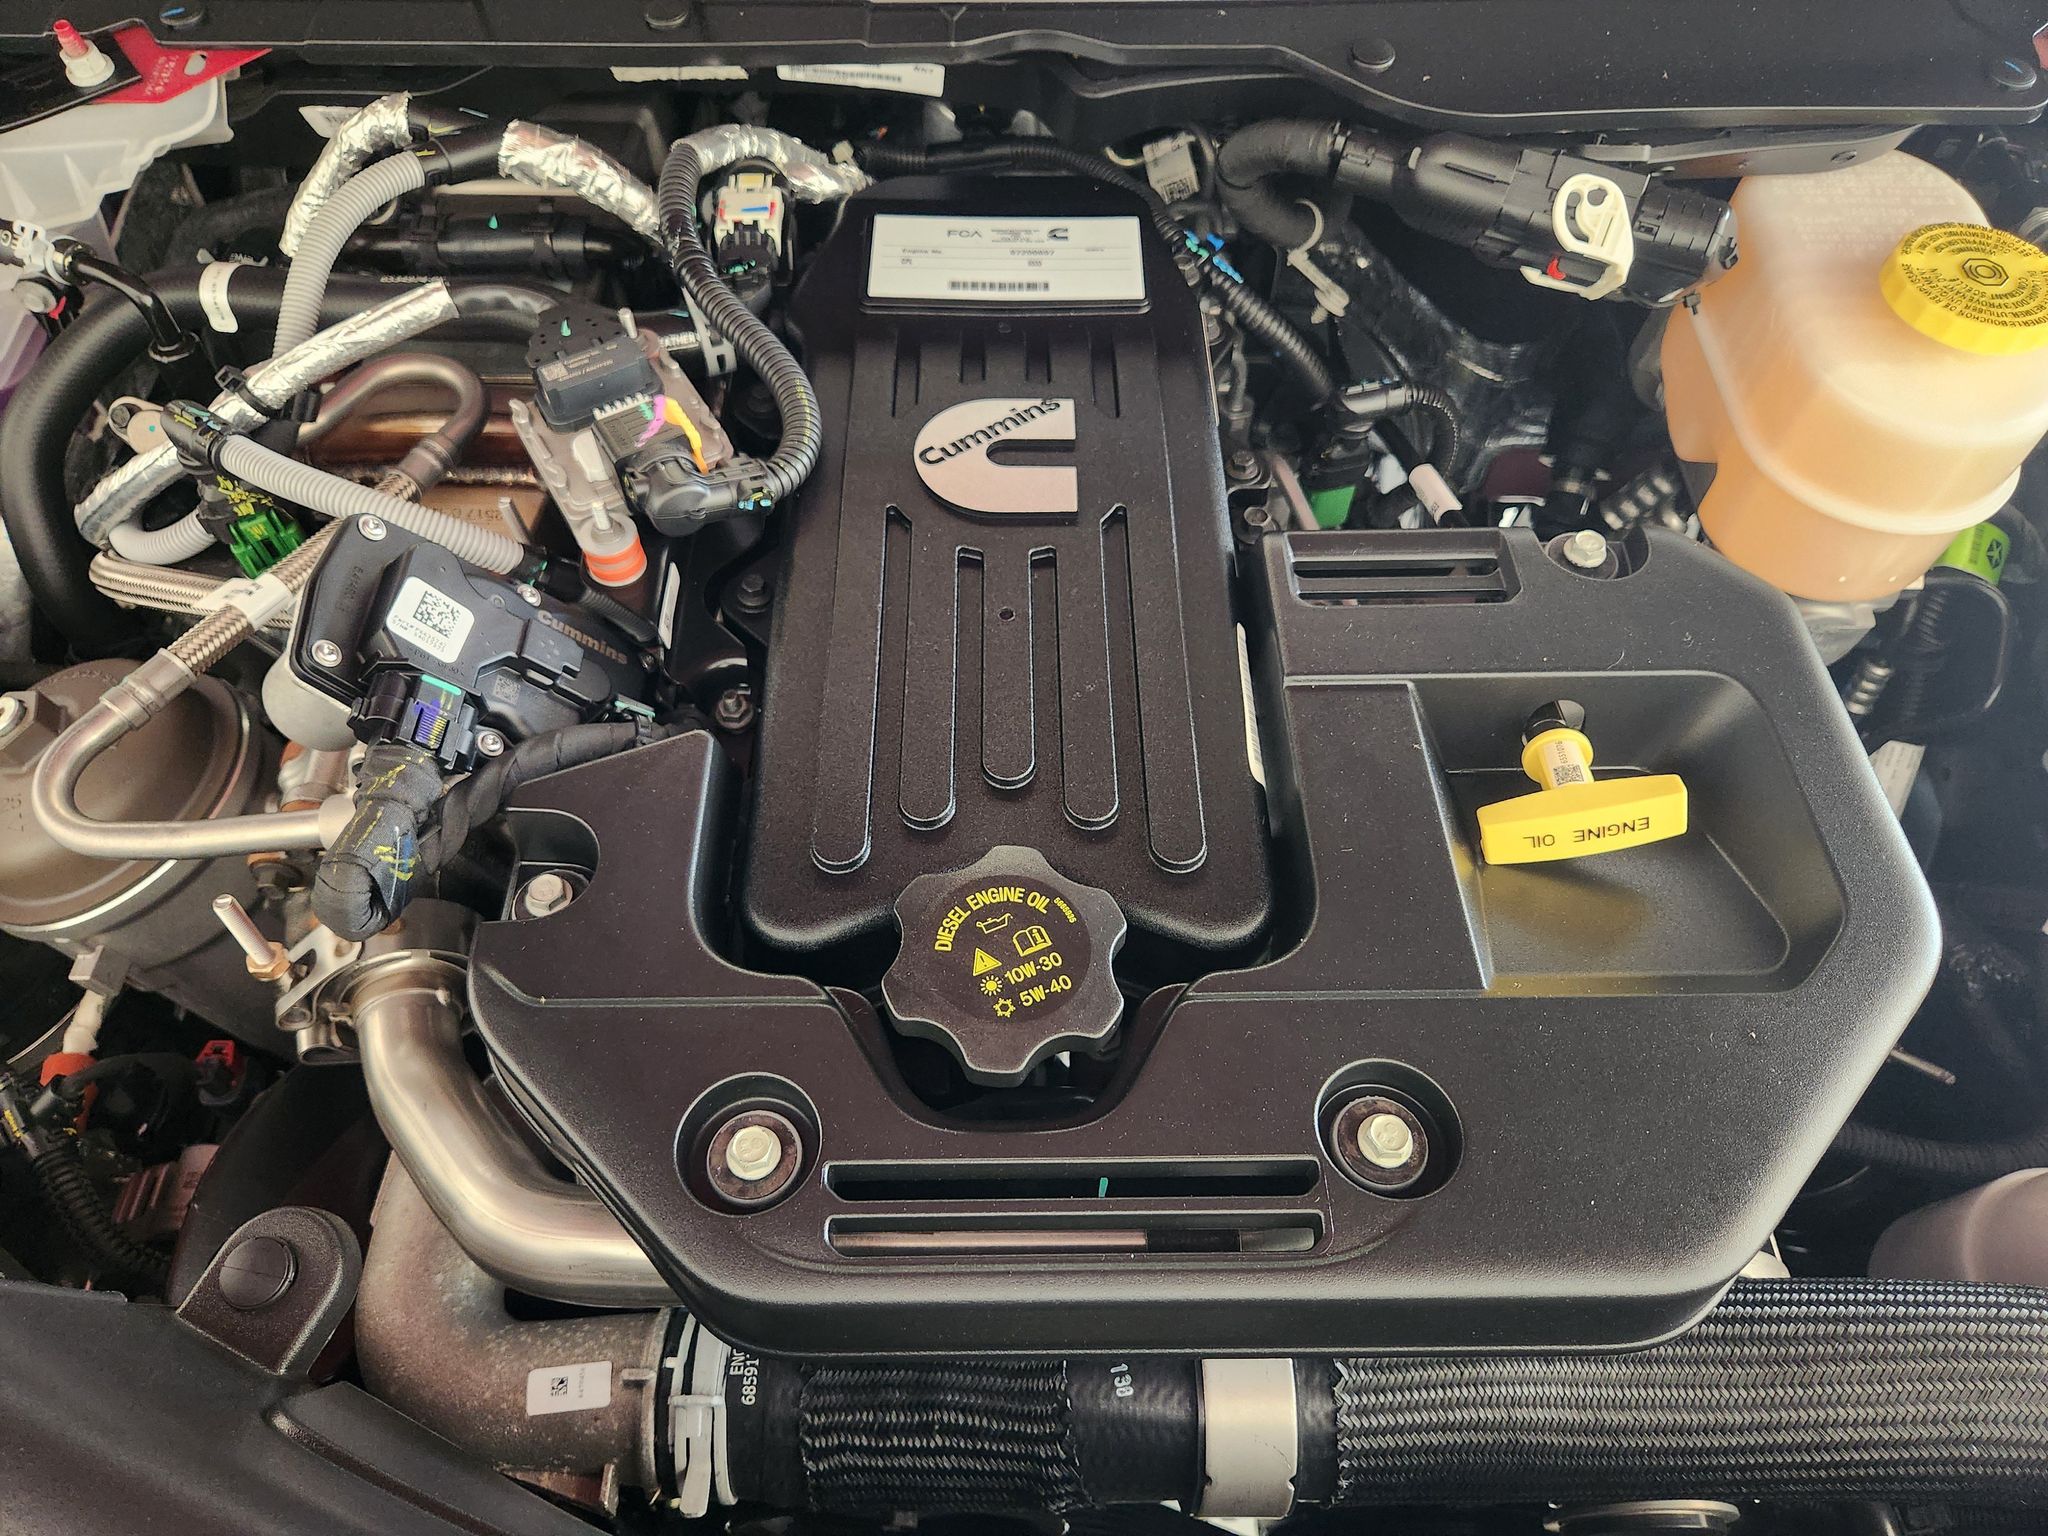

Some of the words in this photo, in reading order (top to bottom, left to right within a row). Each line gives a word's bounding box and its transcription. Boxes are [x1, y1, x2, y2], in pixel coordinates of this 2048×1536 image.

[918, 398, 1061, 466] Cummins
[537, 609, 628, 665] Cummins
[1523, 833, 1556, 849] OIL
[1573, 816, 1650, 844] ENGINE
[934, 906, 971, 952] DIESEL
[965, 886, 1026, 912] ENGINE
[1026, 891, 1051, 914] OIL
[1004, 951, 1063, 985] 10W-30
[1018, 974, 1073, 1007] 5W-40
[740, 1353, 760, 1406] 68591
